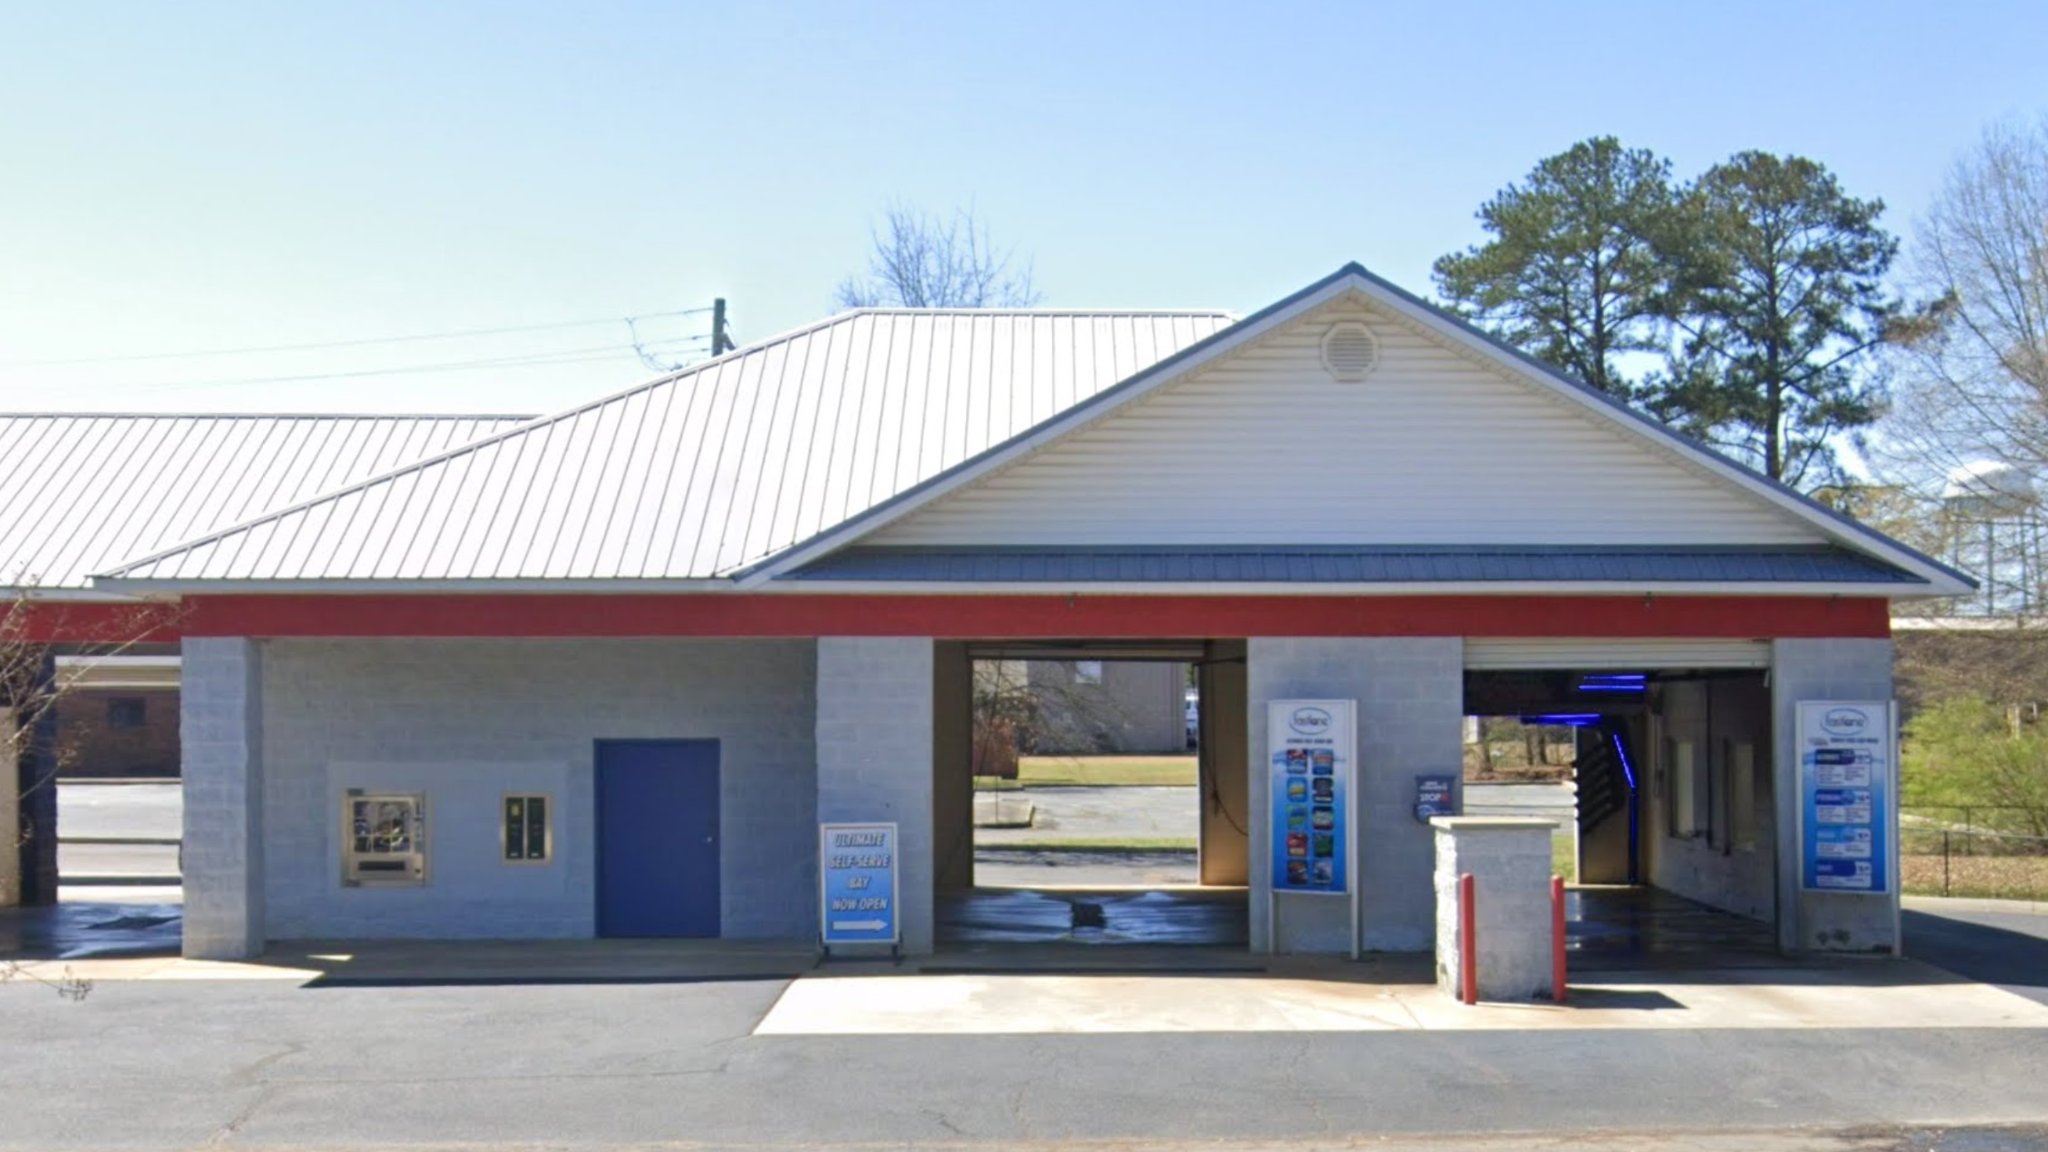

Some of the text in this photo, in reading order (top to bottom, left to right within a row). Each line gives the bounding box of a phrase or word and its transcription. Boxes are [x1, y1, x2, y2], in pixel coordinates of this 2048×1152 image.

[835, 833, 885, 847] ULTIMATE
[831, 855, 890, 868] SELF-SERVE
[848, 877, 871, 890] BAY
[832, 897, 888, 912] NOW OPEN
